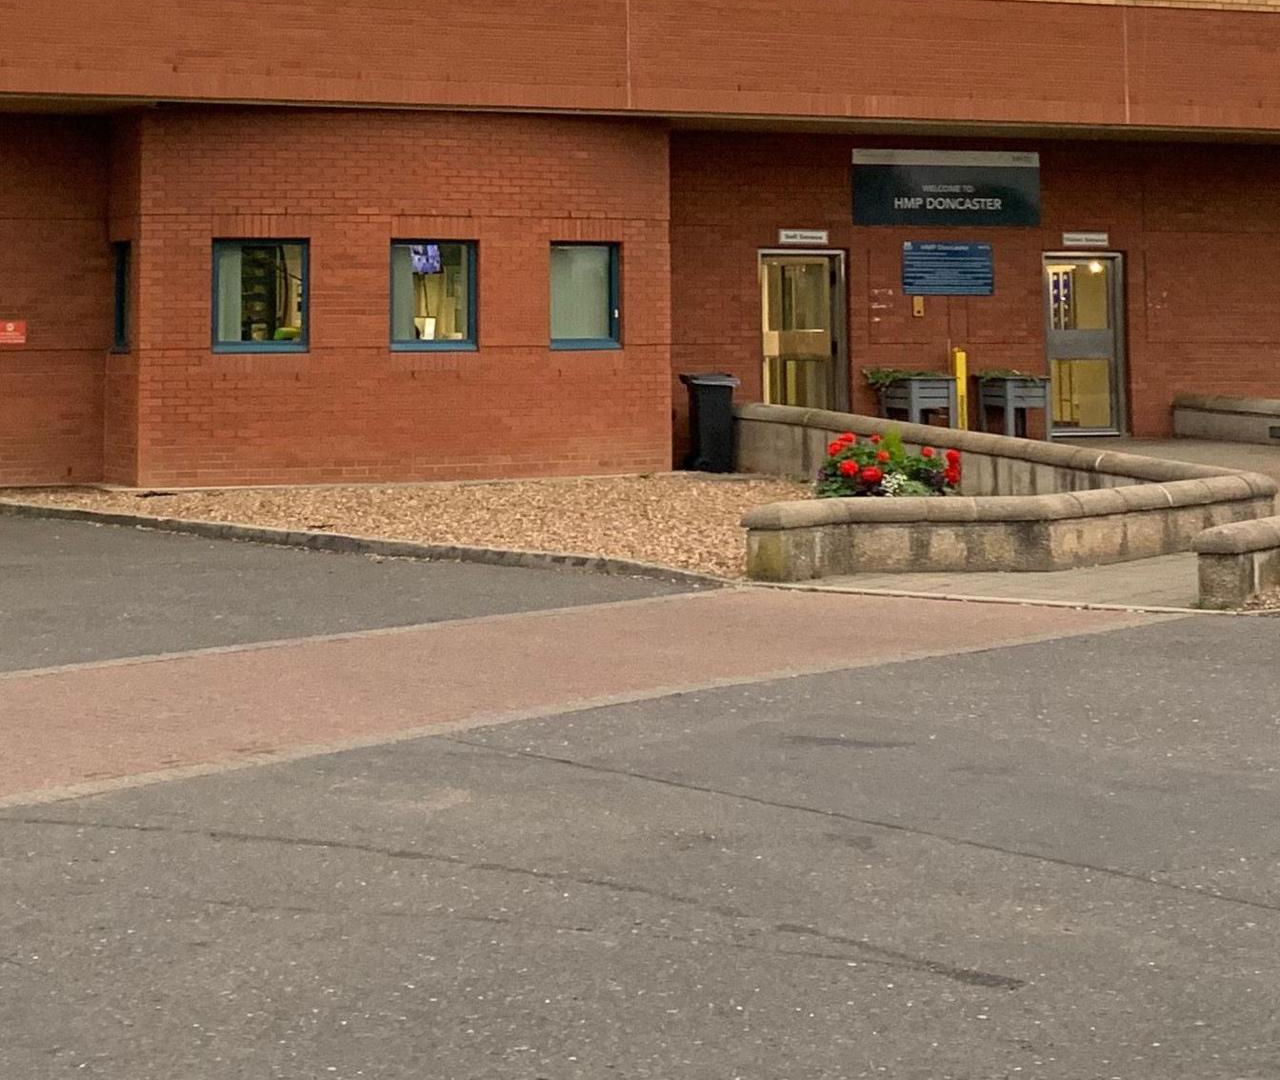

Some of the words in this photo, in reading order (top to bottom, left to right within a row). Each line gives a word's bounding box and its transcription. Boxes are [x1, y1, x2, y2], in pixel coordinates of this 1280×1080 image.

[921, 184, 961, 193] WELCOME
[894, 197, 924, 210] HMP
[926, 197, 1002, 210] DONCASTER
